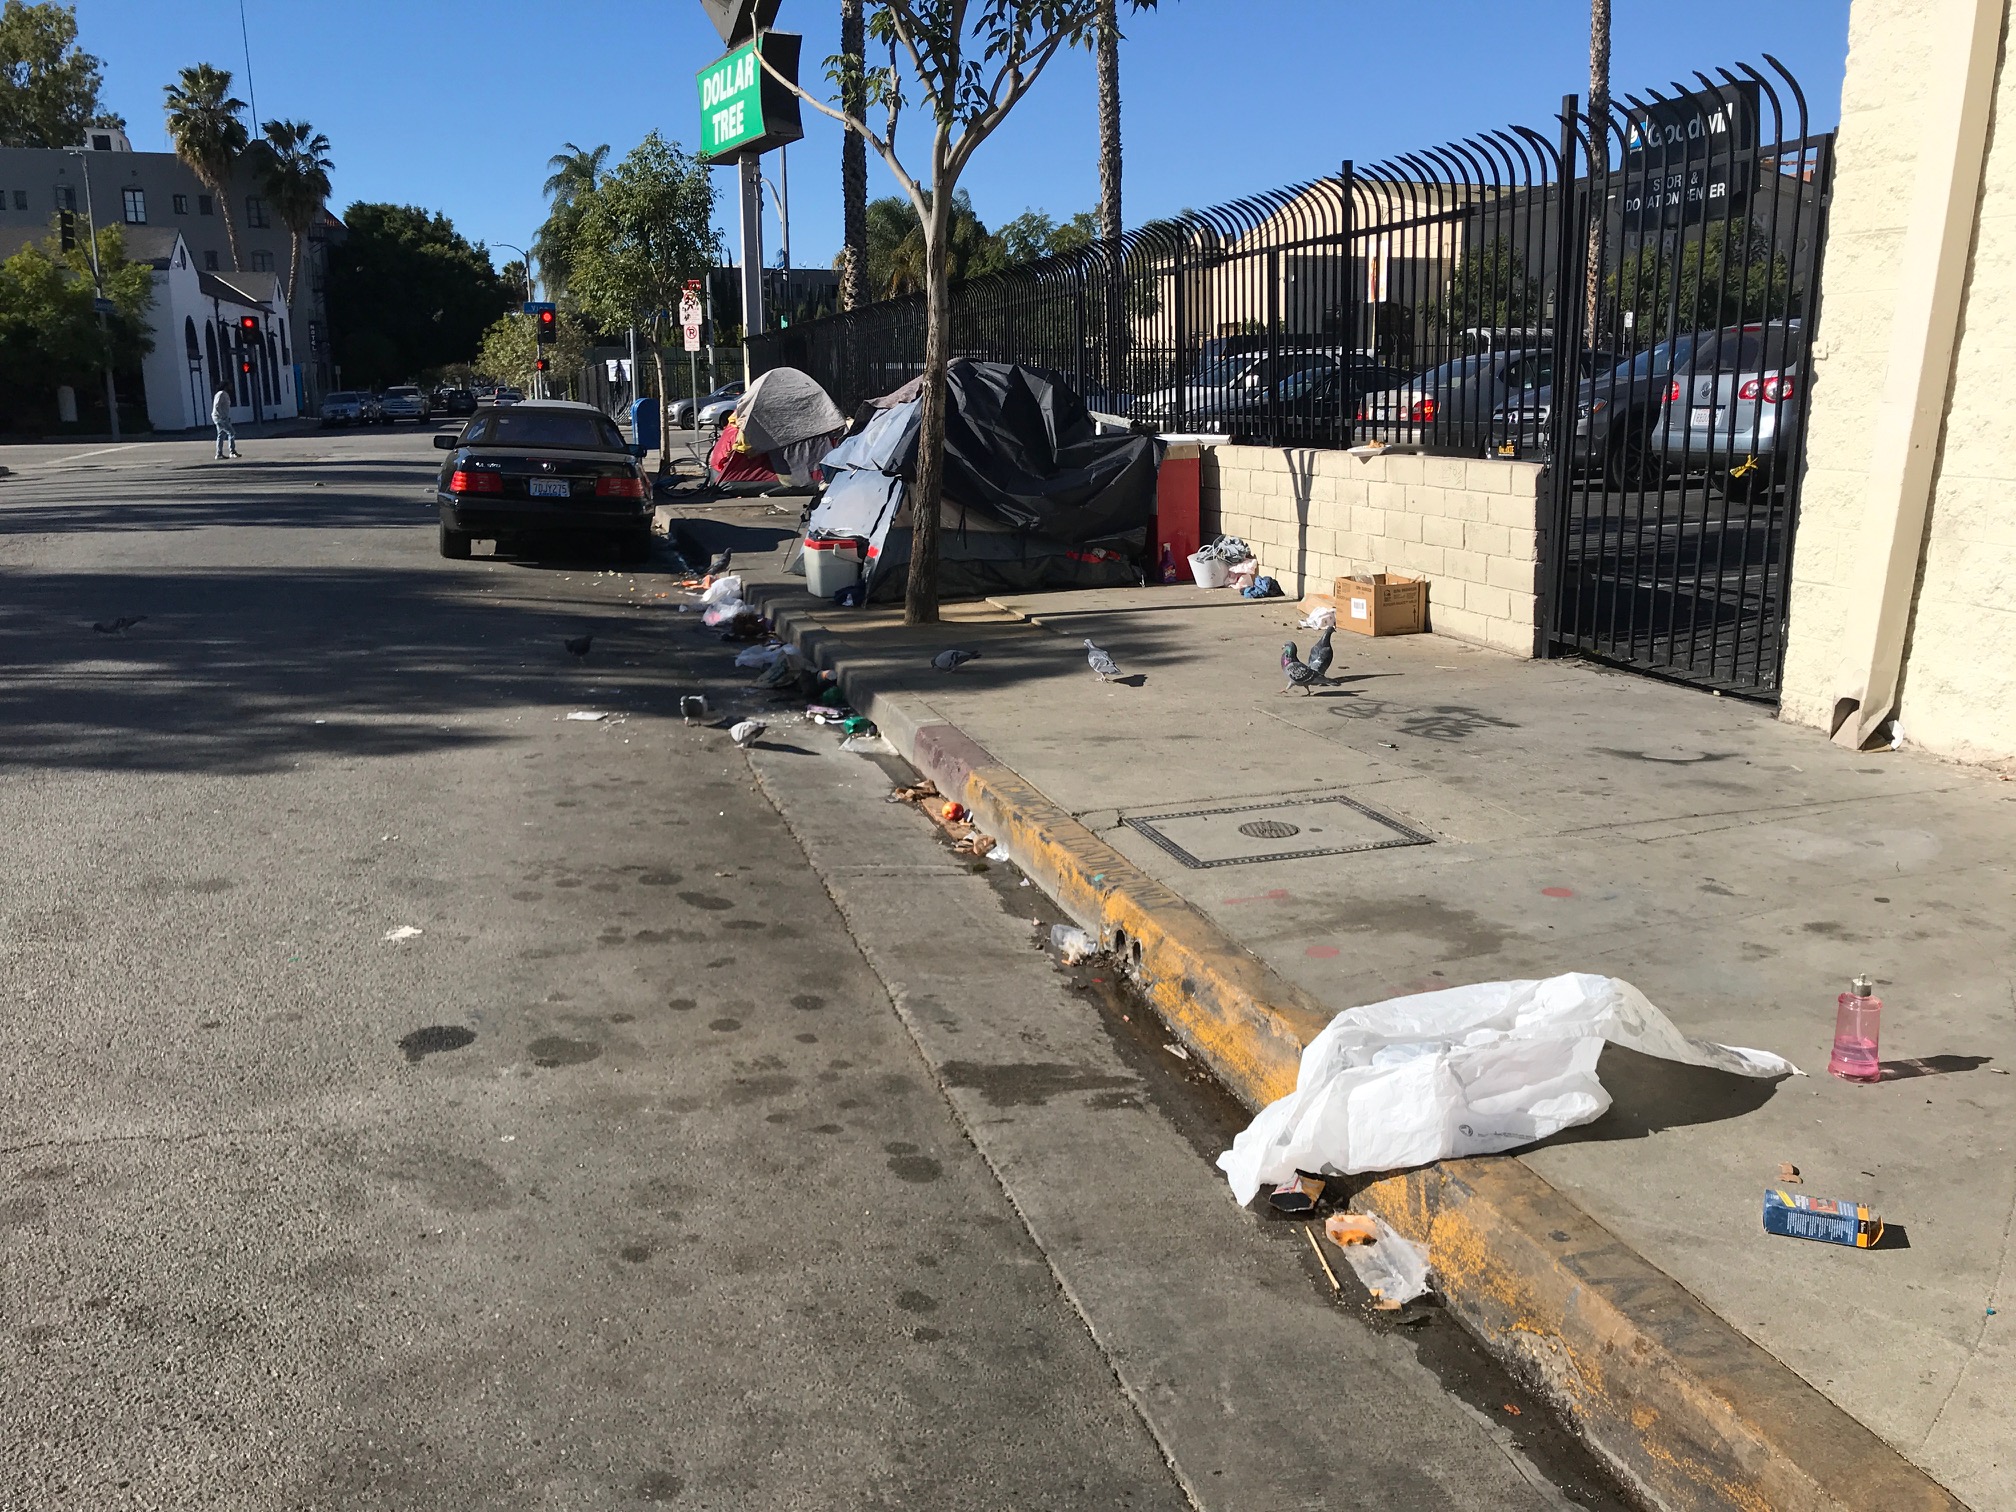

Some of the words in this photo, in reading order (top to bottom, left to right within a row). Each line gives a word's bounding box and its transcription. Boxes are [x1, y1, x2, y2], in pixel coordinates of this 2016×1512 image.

[703, 52, 755, 111] DOLLAR
[712, 100, 745, 146] TREE
[1626, 191, 1680, 213] DOATON
[1686, 182, 1726, 202] ENER
[1653, 174, 1684, 192] SOR
[1690, 171, 1699, 185] &
